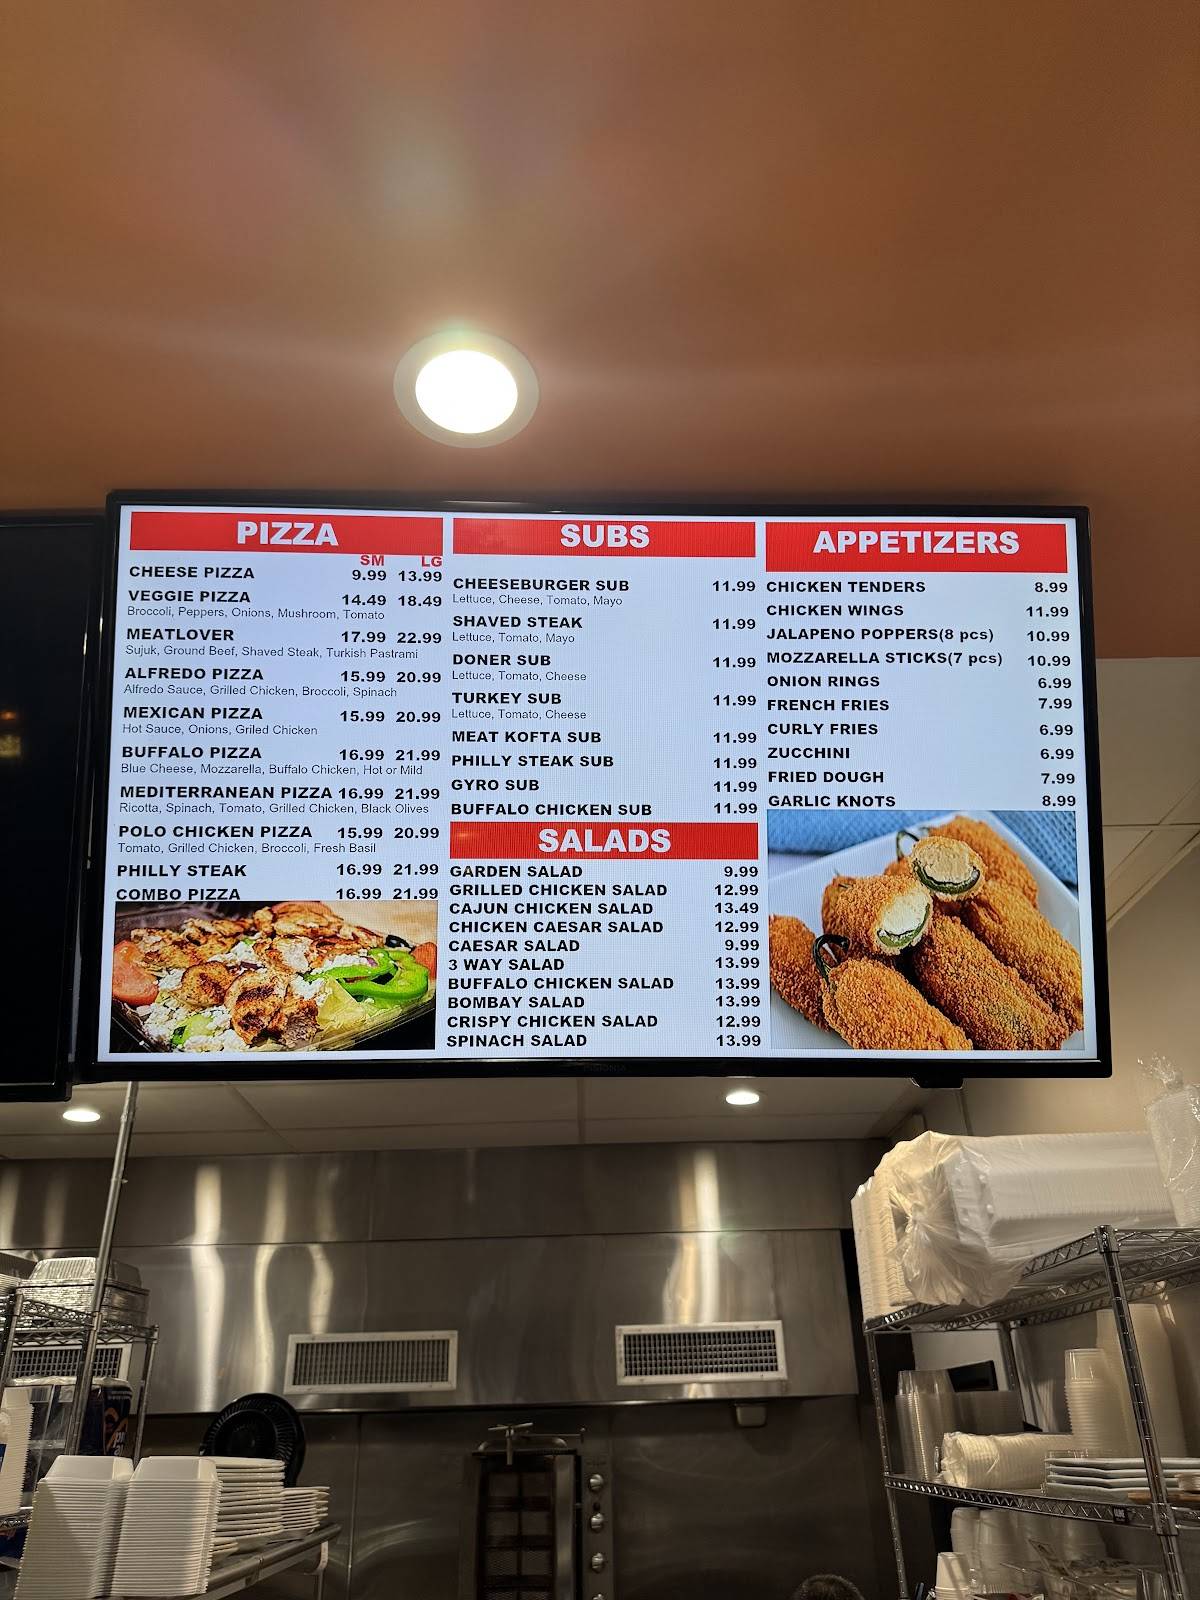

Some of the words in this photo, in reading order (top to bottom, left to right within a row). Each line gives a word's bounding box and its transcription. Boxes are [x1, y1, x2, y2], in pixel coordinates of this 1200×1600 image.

[238, 521, 338, 546] PIZZA
[561, 524, 649, 548] SUBS
[813, 531, 1019, 554] APPETIZERS
[361, 555, 385, 566] SM
[421, 556, 442, 567] LG
[130, 566, 197, 577] CHEESE
[205, 567, 254, 578] PIZZA
[352, 570, 386, 581] 9.99
[399, 571, 442, 582] 13.99
[453, 578, 590, 592] CHEESEBURGER
[596, 580, 629, 591] SUB
[713, 581, 755, 591] 11.99
[767, 582, 841, 592] CHICKEN
[848, 582, 925, 592] TENDERS
[1035, 582, 1067, 592] 8.99
[129, 590, 193, 601] VEGGIE
[200, 591, 250, 602] PIZZA
[342, 594, 386, 605] 14.49
[398, 596, 441, 606] 18.49
[453, 594, 494, 605] Lettuce,
[499, 595, 542, 605] Cheese,
[547, 595, 589, 606] Tomato,
[594, 596, 622, 607] Mayo
[128, 606, 174, 617] Broccoli,
[179, 607, 227, 618] Peppers,
[232, 608, 273, 618] Onions,
[278, 608, 339, 619] Mushroom,
[343, 610, 384, 619] Tomato
[767, 605, 841, 616] CHICKEN
[848, 605, 903, 616] WINGS
[1026, 606, 1068, 617] 11.99
[453, 616, 521, 627] SHAVED
[527, 617, 582, 628] STEAK
[713, 619, 755, 629] 11.99
[127, 628, 234, 640] MEATLOVER
[342, 631, 386, 642] 17.99
[397, 632, 441, 643] 22.99
[453, 632, 494, 643] Lettuce,
[499, 632, 541, 643] Tomato,
[546, 633, 574, 645] Mayo
[767, 629, 855, 639] JALAPENO
[960, 629, 993, 643] pcs)
[1027, 631, 1069, 641] 10.99
[125, 645, 159, 656] Sujuk,
[164, 643, 205, 655] Ground
[209, 646, 237, 656] Beef,
[242, 646, 283, 656] Shaved
[288, 647, 322, 658] Steak,
[326, 648, 366, 657] Turkish
[371, 648, 418, 658] Pastrami
[453, 654, 511, 665] DONER
[517, 655, 551, 666] SUB
[713, 657, 756, 668] 11.99
[767, 652, 879, 663] MOZZARELLA
[969, 653, 1002, 666] pcs)
[1028, 656, 1070, 666] 10.99
[125, 668, 205, 679] ALFREDO
[213, 669, 263, 680] PIZZA
[341, 671, 385, 682] 15.99
[397, 672, 441, 683] 20.99
[768, 676, 821, 687] ONION
[828, 676, 879, 687] RINGS
[1038, 678, 1071, 688] 6.99
[124, 684, 163, 693] Alfredo
[167, 685, 205, 695] Sauce,
[210, 685, 246, 695] Grilled
[250, 686, 297, 696] Chicken,
[303, 686, 348, 697] Broccoli,
[353, 687, 396, 698] Spinach
[452, 692, 522, 704] TURKEY
[528, 693, 561, 704] SUB
[713, 695, 756, 706] 11.99
[124, 707, 204, 718] MEXICAN
[212, 708, 262, 719] PIZZA
[340, 711, 384, 722] 15.99
[396, 712, 440, 722] 20.99
[122, 747, 203, 758] BUFFALO
[210, 747, 261, 758] PIZZA
[340, 749, 384, 760] 16.99
[396, 750, 440, 760] 21.99
[768, 748, 849, 758] ZUCCHINI
[1041, 749, 1074, 759] 6.99
[122, 763, 146, 773] Blue
[150, 764, 196, 774] Cheese,
[201, 764, 264, 775] Mozzarella,
[270, 764, 307, 774] Buffalo
[312, 765, 359, 775] Chicken,
[364, 765, 382, 774] Hot
[401, 765, 422, 774] Mild
[768, 771, 817, 782] FRIED
[824, 772, 883, 783] DOUGH
[1041, 773, 1075, 784] 7.99
[451, 779, 499, 790] GYRO
[505, 780, 539, 790] SUB
[714, 781, 757, 792] 11.99
[121, 786, 274, 798] MEDITERRANEAN
[281, 787, 332, 798] PIZZA
[339, 788, 383, 799] 16.99
[395, 788, 439, 799] 21.99
[768, 795, 830, 807] GARLIC
[837, 796, 895, 807] KNOTS
[1042, 795, 1076, 806] 8.99
[452, 804, 529, 815] BUFFALO
[536, 804, 611, 815] CHICKEN
[618, 805, 652, 815] SUB
[714, 803, 757, 814] 11.99
[119, 826, 166, 837] POLO
[173, 826, 253, 837] CHICKEN
[261, 826, 312, 837] PIZZA
[338, 827, 382, 838] 15.99
[394, 828, 439, 838] 20.99
[538, 829, 671, 852] SALADS
[118, 843, 163, 853] Tomato,
[168, 843, 204, 852] Grilled
[209, 843, 257, 854] Chicken,
[262, 843, 309, 853] Broccoli,
[314, 843, 345, 852] Fresh
[350, 843, 375, 852] Basil
[118, 865, 181, 876] PHILLY
[187, 865, 246, 876] STEAK
[337, 864, 382, 875] 16.99
[394, 864, 438, 875] 21.99
[450, 866, 520, 877] GARDEN
[527, 866, 582, 877] SALAD
[724, 866, 758, 877] 9.99
[117, 889, 181, 899] COMBO
[189, 889, 240, 899] PIZZA
[337, 888, 381, 899] 16.99
[393, 888, 438, 901] 21.99
[450, 884, 522, 895] GRILLED
[529, 884, 605, 895] CHICKEN
[612, 885, 667, 896] SALAD
[715, 884, 758, 895] 12.99
[450, 903, 507, 914] CAJUN
[515, 903, 591, 914] CHICKEN
[598, 903, 653, 914] SALAD
[715, 903, 758, 913] 13.49
[449, 959, 457, 970] 3
[464, 959, 502, 970] WAY
[509, 959, 564, 970] SALAD
[716, 957, 759, 968] 13.99
[448, 1016, 511, 1028] CRISPY
[518, 1016, 595, 1027] CHICKEN
[602, 1015, 657, 1027] SALAD
[716, 1016, 760, 1027] 12.99
[447, 1035, 524, 1047] SPINACH
[531, 1035, 587, 1046] SALAD
[717, 1035, 761, 1046] 13.99
